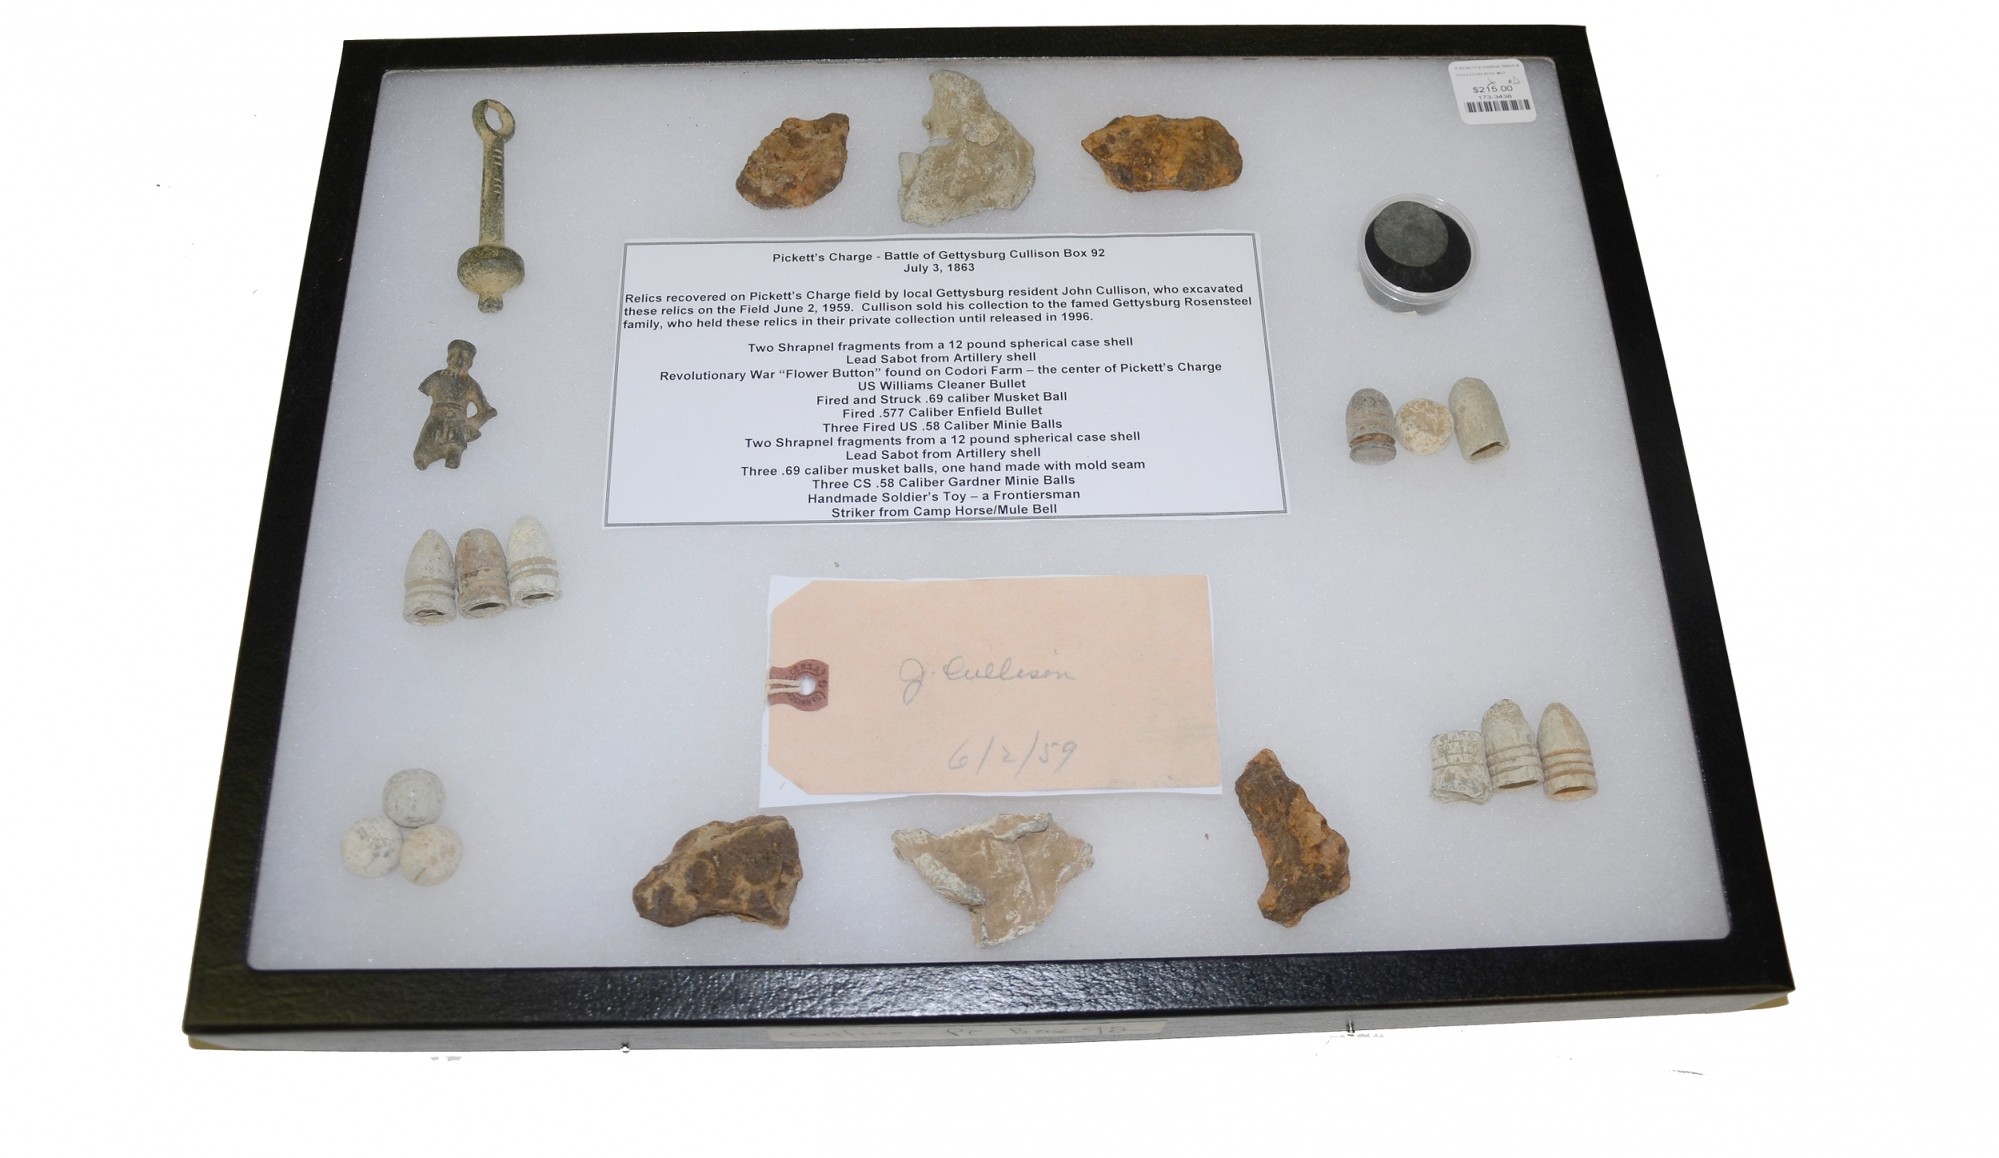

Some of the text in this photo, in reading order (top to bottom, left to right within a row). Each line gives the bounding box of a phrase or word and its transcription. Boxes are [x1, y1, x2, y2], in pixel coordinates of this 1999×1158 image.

[1473, 85, 1514, 94] $215.00
[828, 252, 873, 263] Charge
[884, 251, 919, 261] Battle
[922, 250, 936, 260] of
[938, 250, 1006, 262] Gettysburg
[1009, 249, 1060, 259] Cullison
[1063, 248, 1087, 258] Box
[1090, 248, 1105, 257] 92
[903, 262, 975, 274] July 3, 1863
[625, 293, 662, 305] Relics
[666, 292, 726, 302] recovered
[730, 293, 746, 301] on
[806, 290, 851, 301] Charge
[854, 289, 881, 299] field
[884, 289, 899, 301] by
[903, 288, 932, 298] local
[935, 287, 1004, 300] Gettysburg
[1008, 286, 1058, 297] resident
[1061, 286, 1092, 295] John
[1095, 285, 1150, 295] Cullison,
[1152, 284, 1179, 294] who
[1182, 284, 1244, 294] excavated
[623, 296, 1252, 317] these relics on the Field June 2, 1959. Cullison sold his collection to the famed Gettysburg Rosensteel
[623, 311, 1093, 330] family, who held these relics in their private collection until released in 1996.
[747, 343, 774, 353] Two
[777, 342, 834, 354] Shrapnel
[837, 341, 901, 353] fragments
[904, 340, 934, 350] from
[948, 339, 963, 349] 12
[966, 339, 1006, 351] pound
[1009, 338, 1067, 350] spherical
[1070, 339, 1100, 347] case
[1103, 336, 1133, 346] shell
[846, 351, 1036, 364] Lead Sabot from Artillery shell
[659, 370, 746, 382] Revolutionary
[749, 369, 776, 379] War
[884, 366, 922, 377] found
[925, 368, 941, 376] on
[944, 365, 987, 376] Codori
[991, 365, 1022, 375] Farm
[1037, 364, 1057, 374] the
[1061, 364, 1100, 374] center
[1104, 363, 1117, 373] of
[1177, 362, 1222, 374] Charge
[858, 378, 1026, 391] US Williams Cleaner Bullet
[816, 391, 1067, 405] Fired and Struck .69 caliber Musket Ball
[842, 405, 1043, 418] Fired .577 Caliber Enfield Bullet
[822, 418, 1062, 433] Three Fired US .58 Caliber Minie Balls
[744, 431, 1140, 449] Two Shrapnel fragments from a 12 pound spherical case shell
[845, 447, 1041, 460] Lead Sabot from Artillery shell
[740, 459, 1146, 476] Three .69 caliber musket balls, one hand made with mold seam
[811, 474, 1076, 489] Three CS .58 Caliber Gardner Minie Balls
[807, 492, 878, 504] Handmade
[942, 491, 966, 503] Toy
[981, 492, 990, 501] a
[993, 489, 1080, 500] Frontiersman
[831, 503, 1057, 519] Striker from Camp Horse/Mule Bell
[948, 731, 1078, 779] 6/2/59
